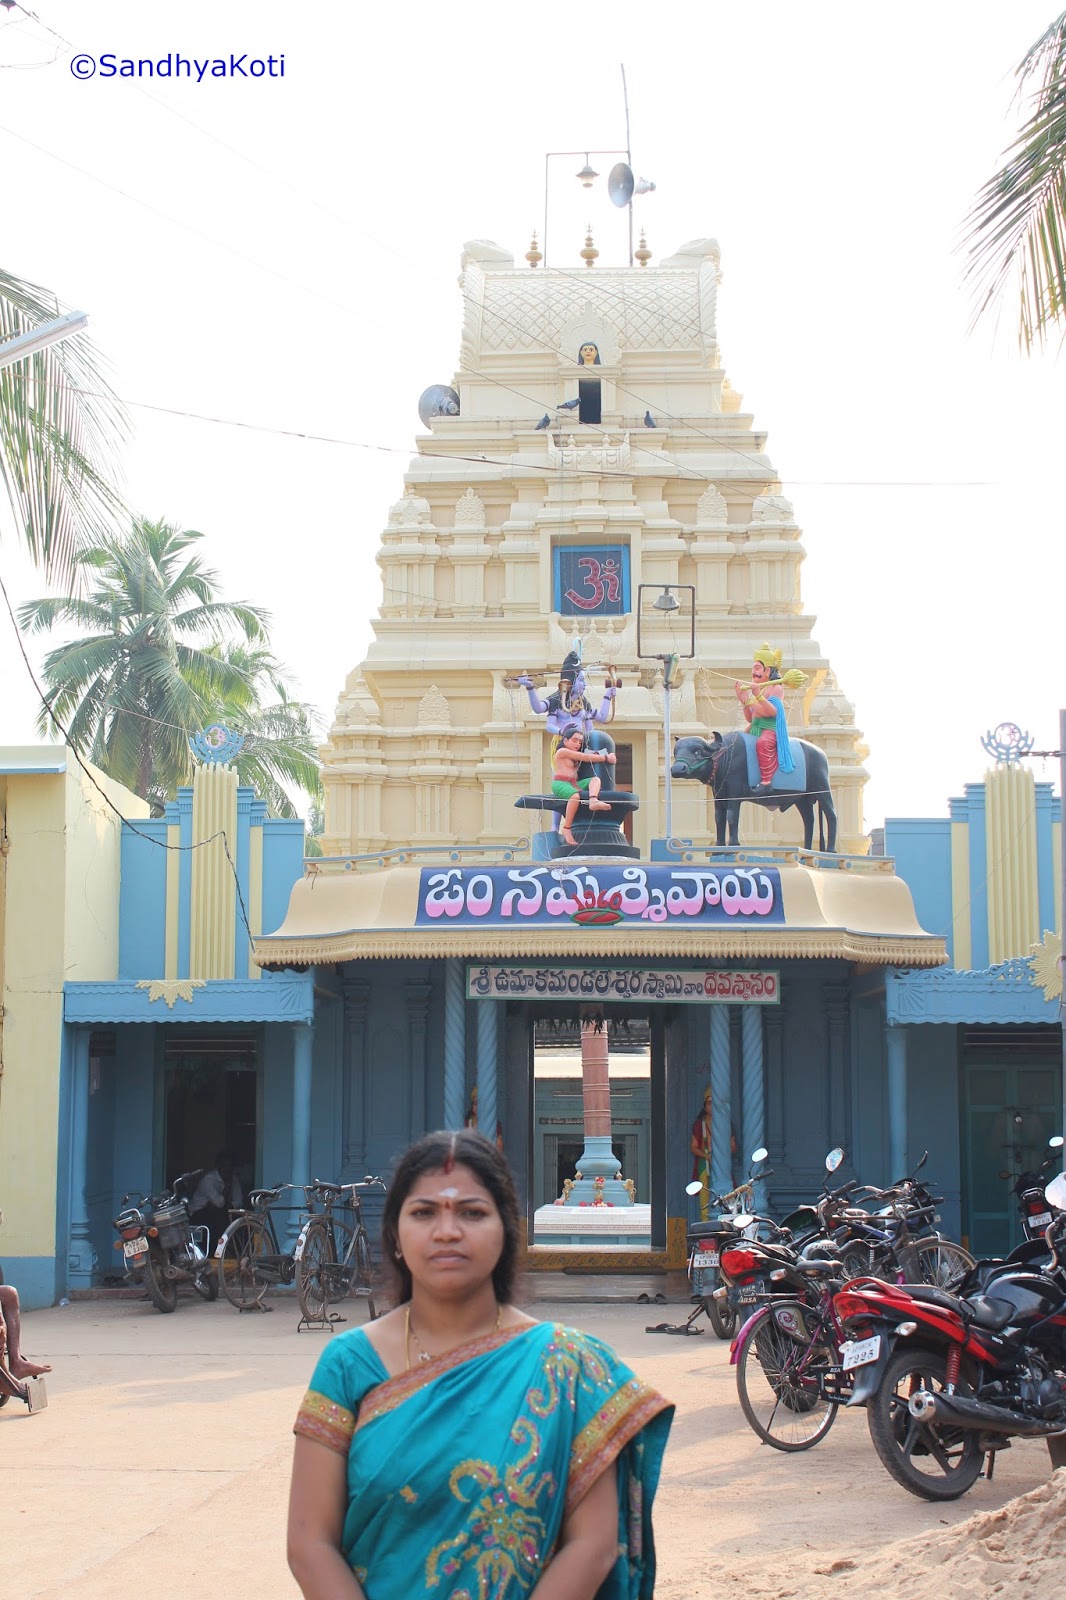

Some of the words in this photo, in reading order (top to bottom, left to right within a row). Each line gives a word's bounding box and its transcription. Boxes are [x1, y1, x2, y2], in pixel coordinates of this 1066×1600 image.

[425, 868, 493, 918] ఓం
[471, 966, 491, 995] శ్రీ
[847, 1349, 874, 1366] 7225
